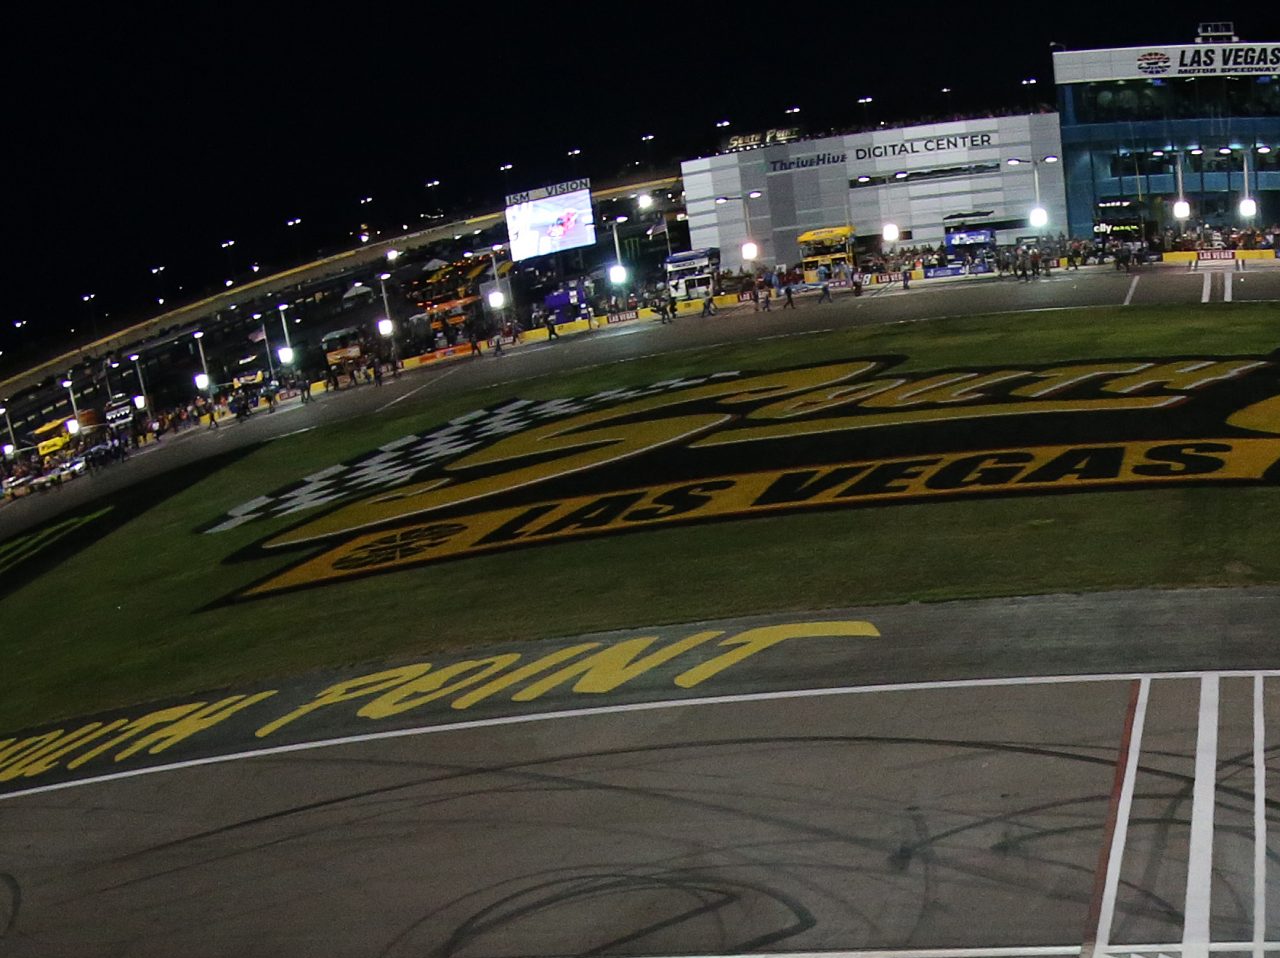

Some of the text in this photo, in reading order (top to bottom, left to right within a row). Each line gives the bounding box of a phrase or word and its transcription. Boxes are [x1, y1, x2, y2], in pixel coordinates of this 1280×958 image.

[1179, 49, 1215, 68] LAS
[1221, 66, 1278, 74] SPEEDWAY
[856, 142, 919, 160] DIGITAL
[925, 134, 991, 152] CENTER
[508, 180, 588, 205] ISM VISION
[1199, 251, 1233, 260] LAS VEGAS
[609, 312, 638, 323] LAS VEGAS
[470, 482, 732, 546] LAS
[750, 441, 1236, 507] VEGAS
[0, 621, 880, 782] OUTH POINT
